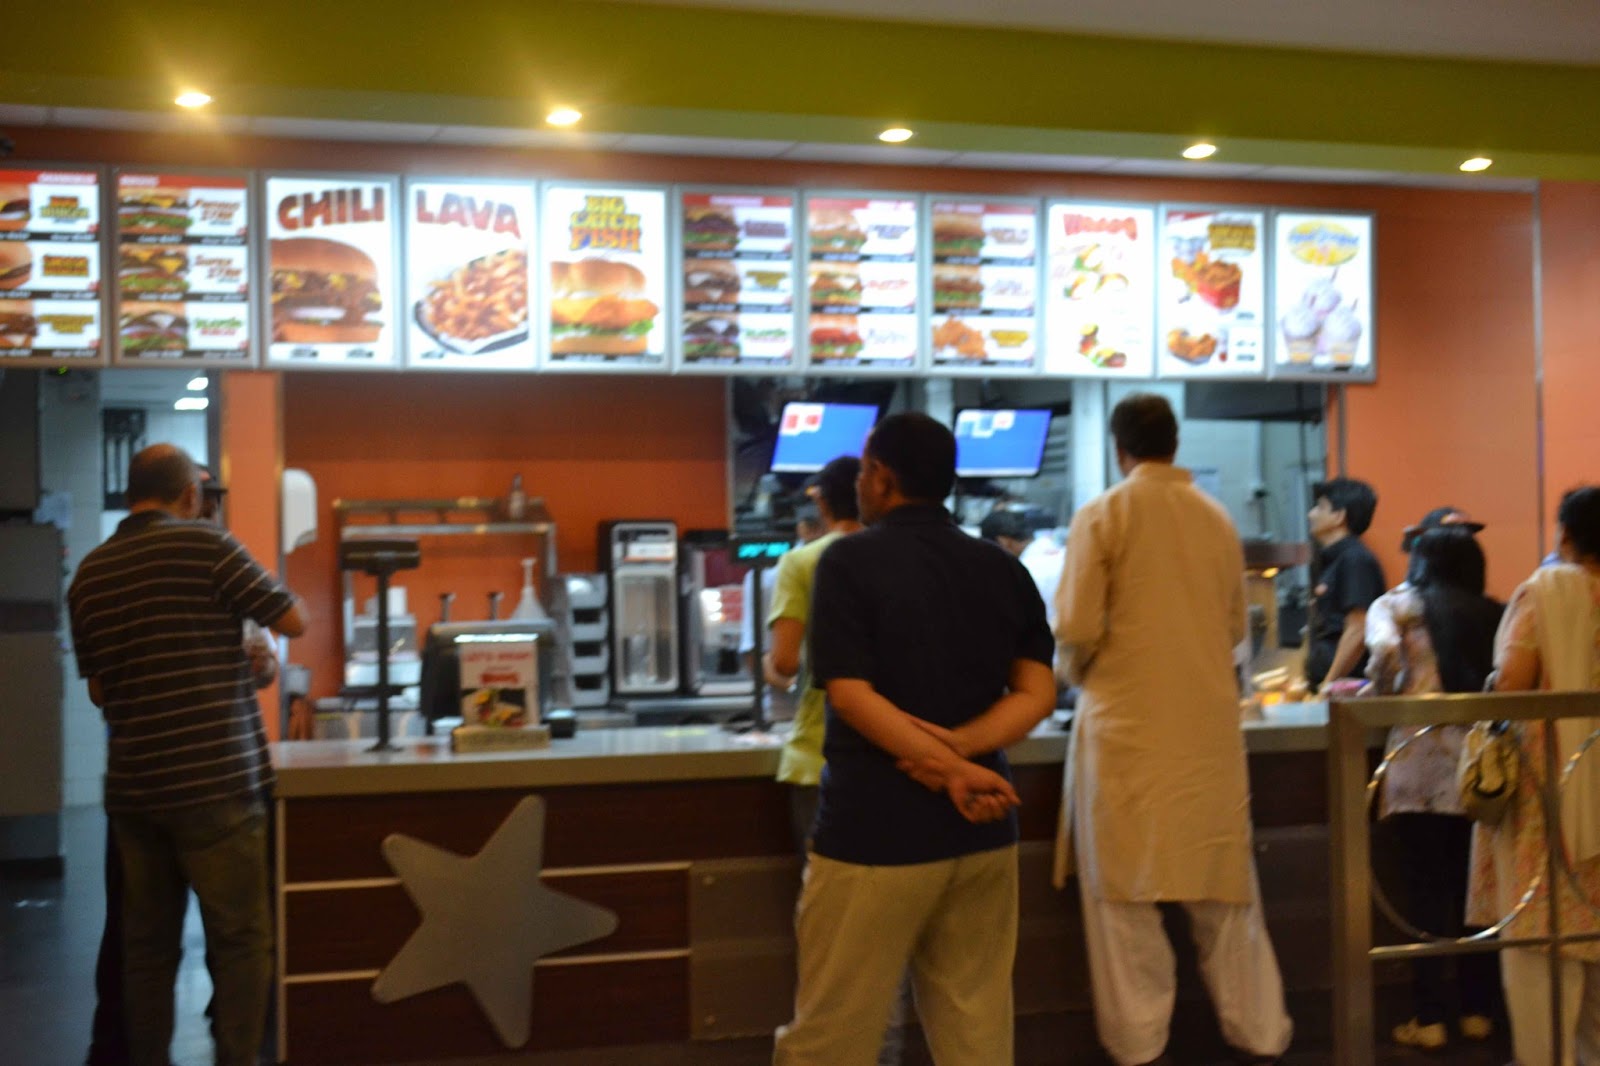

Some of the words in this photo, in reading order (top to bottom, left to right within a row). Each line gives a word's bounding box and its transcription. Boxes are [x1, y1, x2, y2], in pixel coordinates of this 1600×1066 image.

[278, 187, 385, 231] CHILI
[416, 189, 521, 239] LAVA
[569, 227, 642, 252] FISH
